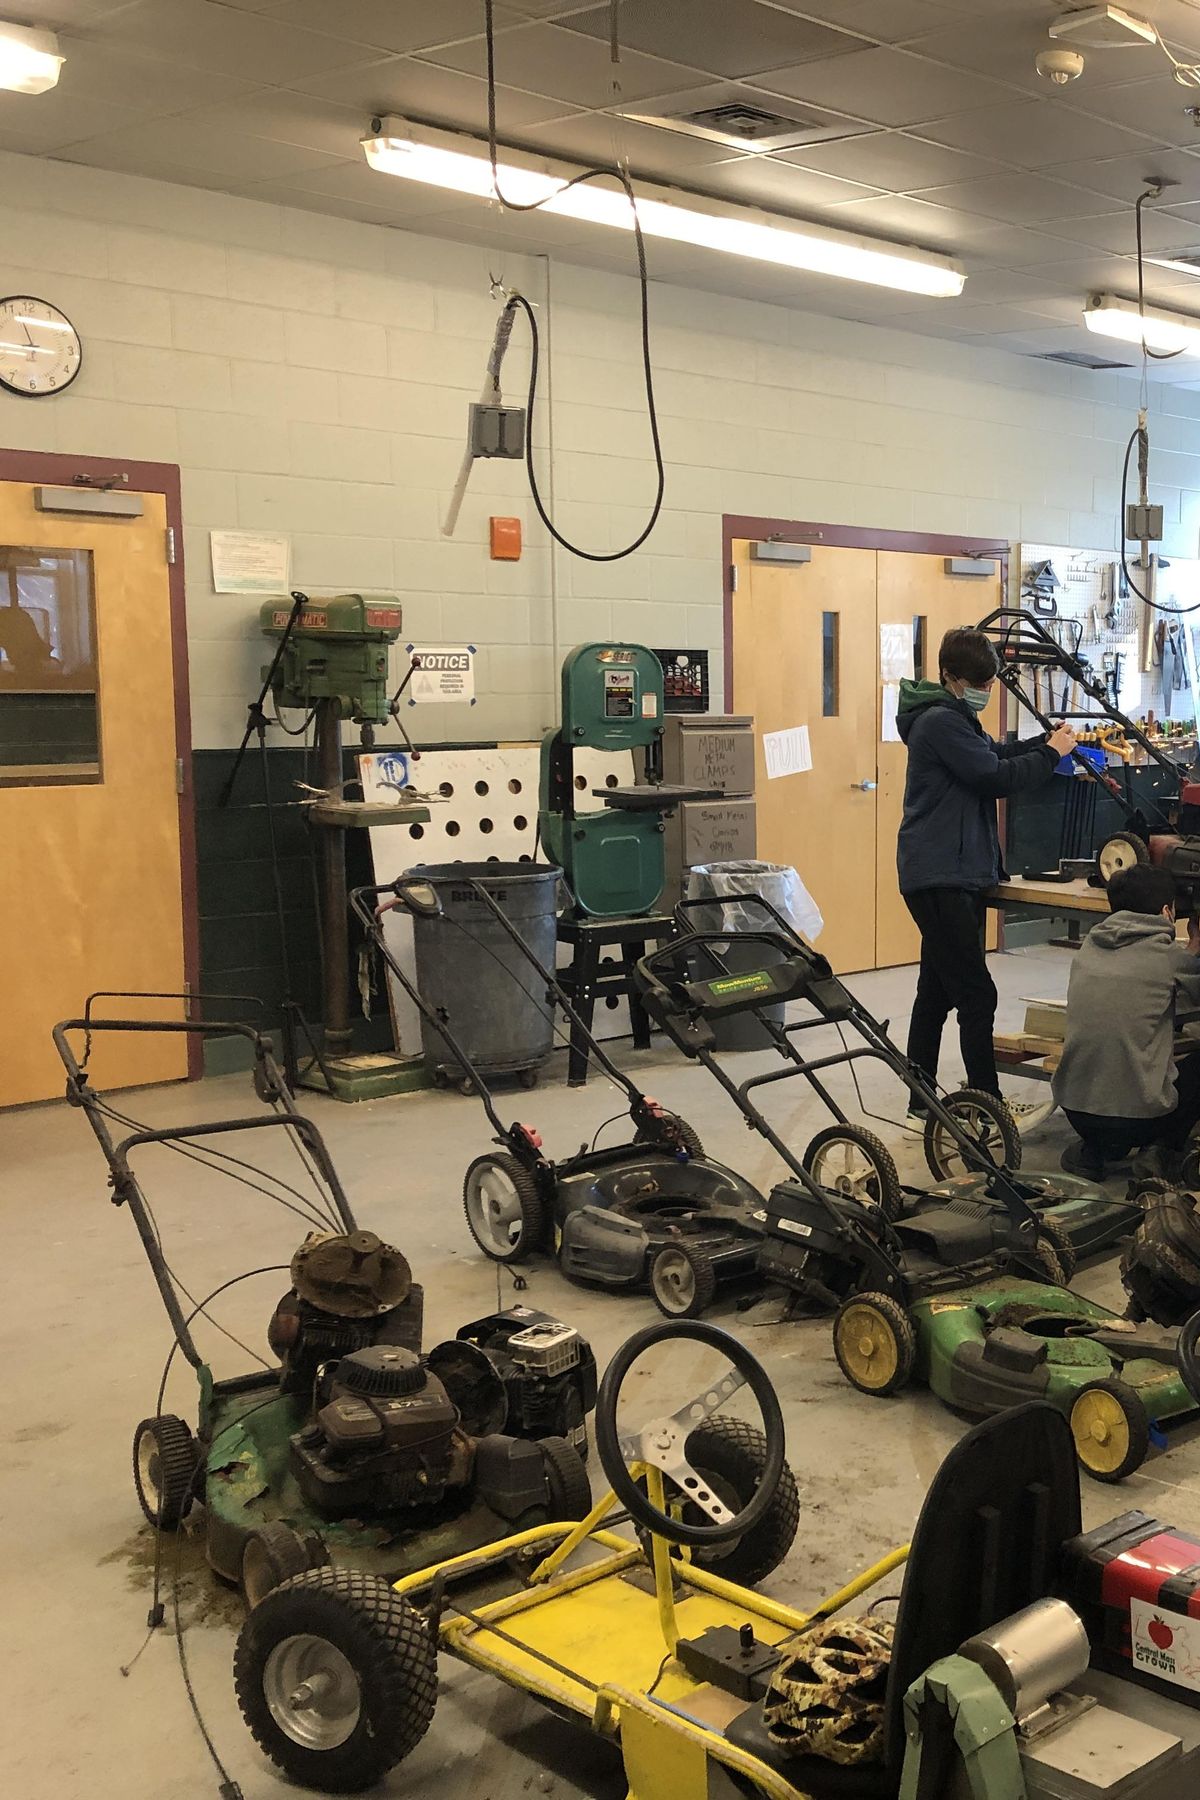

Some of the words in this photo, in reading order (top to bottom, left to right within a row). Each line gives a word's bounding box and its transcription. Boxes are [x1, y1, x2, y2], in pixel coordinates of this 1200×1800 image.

[3, 304, 14, 313] 11
[23, 303, 35, 313] 12
[47, 311, 52, 319] 1
[67, 346, 74, 356] 3
[63, 365, 70, 374] 4
[9, 372, 16, 382] 7
[49, 377, 56, 387] 5
[29, 380, 37, 390] 6
[698, 736, 736, 752] MEDIUM
[693, 765, 736, 780] CLAMPS
[1135, 1642, 1159, 1658] Central
[1159, 1650, 1176, 1664] Mass
